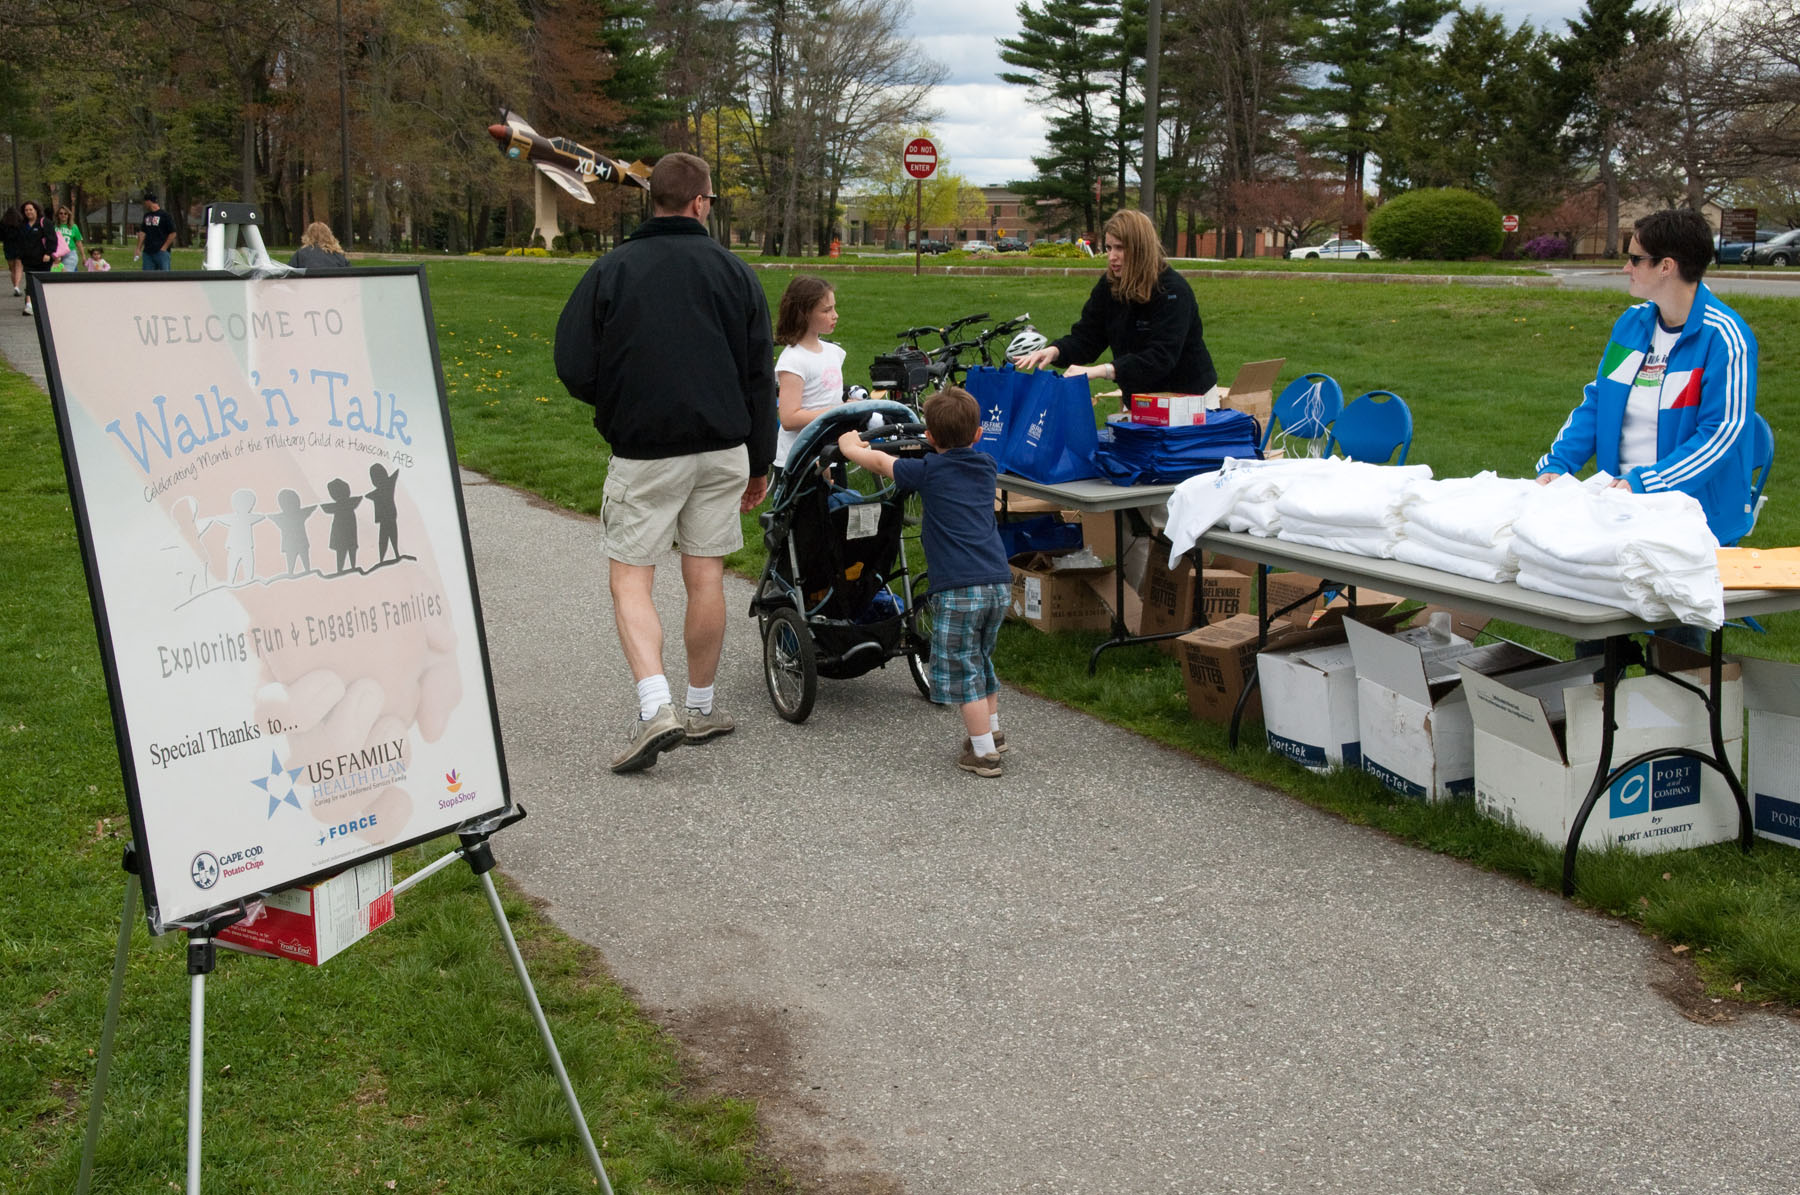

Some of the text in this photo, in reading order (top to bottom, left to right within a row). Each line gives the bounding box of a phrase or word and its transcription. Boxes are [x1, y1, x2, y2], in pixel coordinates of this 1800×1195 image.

[134, 309, 343, 346] WELCOME TO
[105, 385, 248, 474] Walk
[310, 369, 412, 445] Talk
[144, 432, 414, 503] Celebrating Month of the Military Child at Hanscom AFB
[1203, 579, 1218, 587] Pack
[1203, 588, 1240, 598] BELIEVABLE
[1203, 599, 1240, 613] UTTER
[157, 593, 442, 678] Exploring Fun & Engaging Families
[1189, 663, 1224, 685] BUTTER
[150, 731, 204, 769] Special
[207, 720, 261, 751] Thanks
[1270, 735, 1306, 757] Sport-Tek
[308, 739, 404, 784] US FAMILY
[312, 760, 406, 798] HEALTH PLAN
[1367, 762, 1409, 793] Sport-Tek
[1656, 766, 1691, 781] PORT
[1666, 777, 1681, 787] and
[1654, 786, 1691, 799] COMPANY
[329, 814, 377, 839] FORCE
[1651, 816, 1663, 825] by
[1618, 822, 1694, 843] PORT AUTHORITY
[220, 845, 264, 866] CAPE COD
[223, 859, 264, 878] Potato Chips
